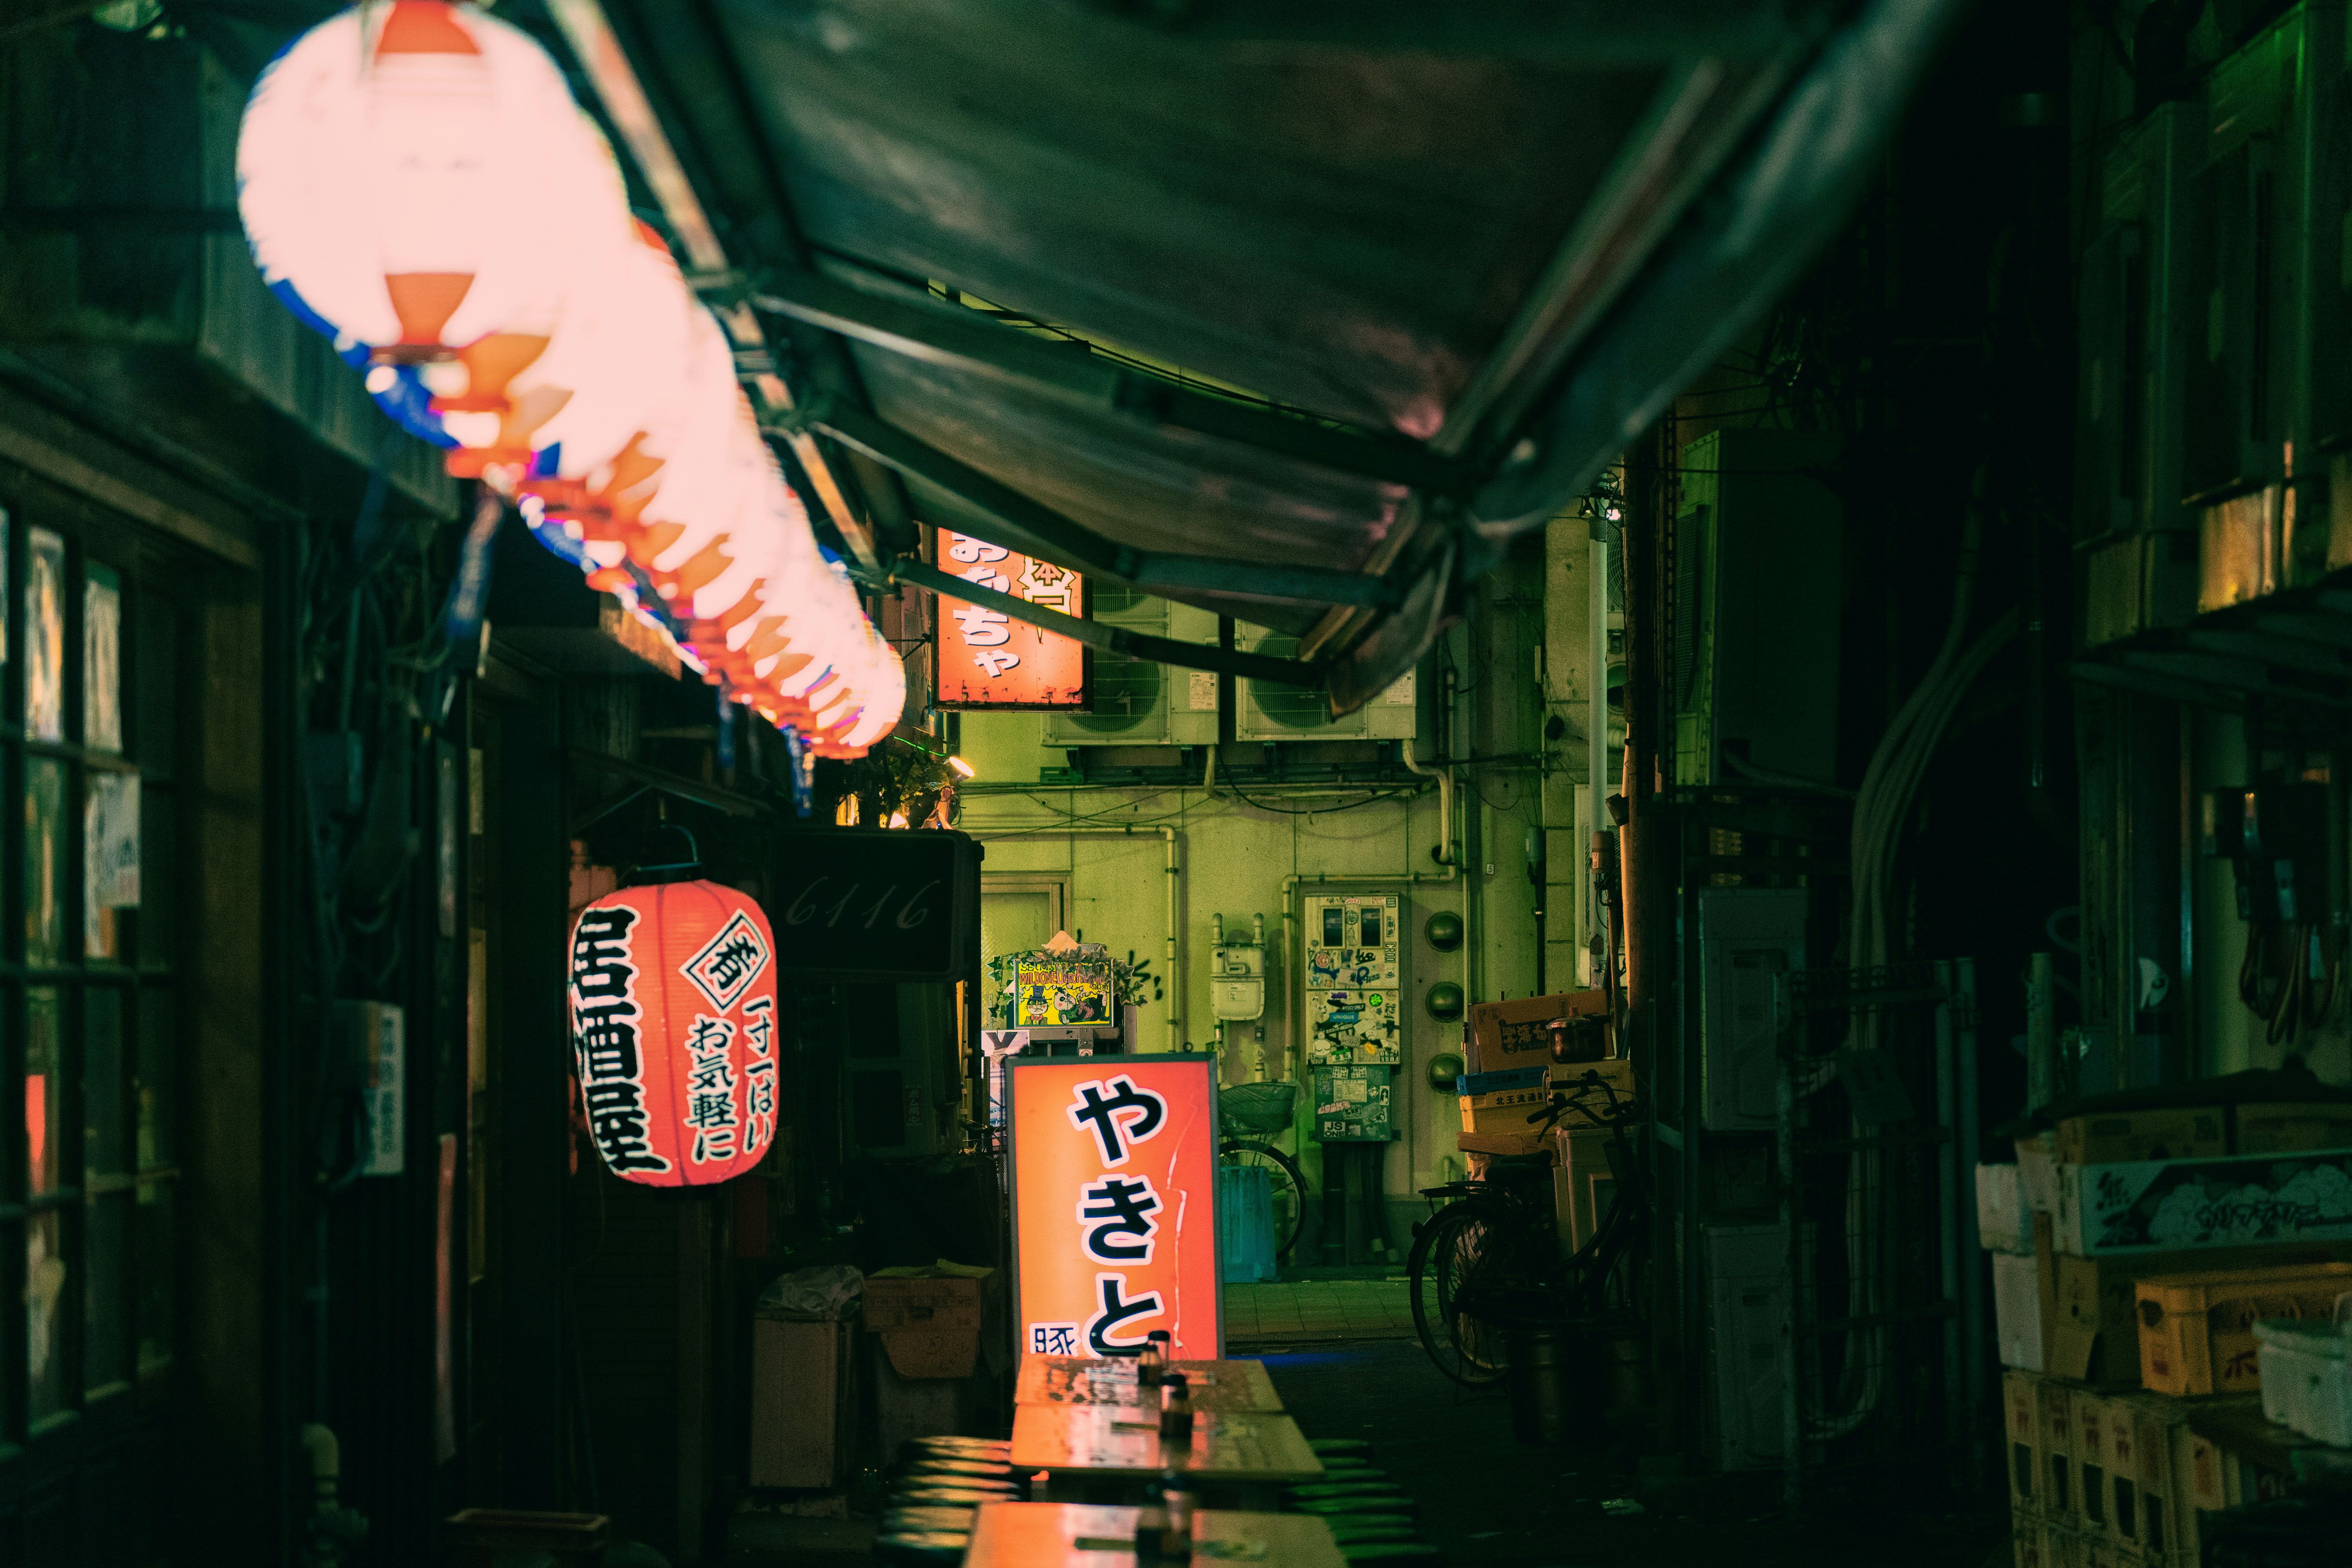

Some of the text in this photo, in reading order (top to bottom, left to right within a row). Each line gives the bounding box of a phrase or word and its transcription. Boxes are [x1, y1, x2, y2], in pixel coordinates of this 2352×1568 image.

[785, 876, 940, 929] 6116
[684, 1013, 741, 1165] お気軽に
[1327, 1122, 1342, 1130] JS
